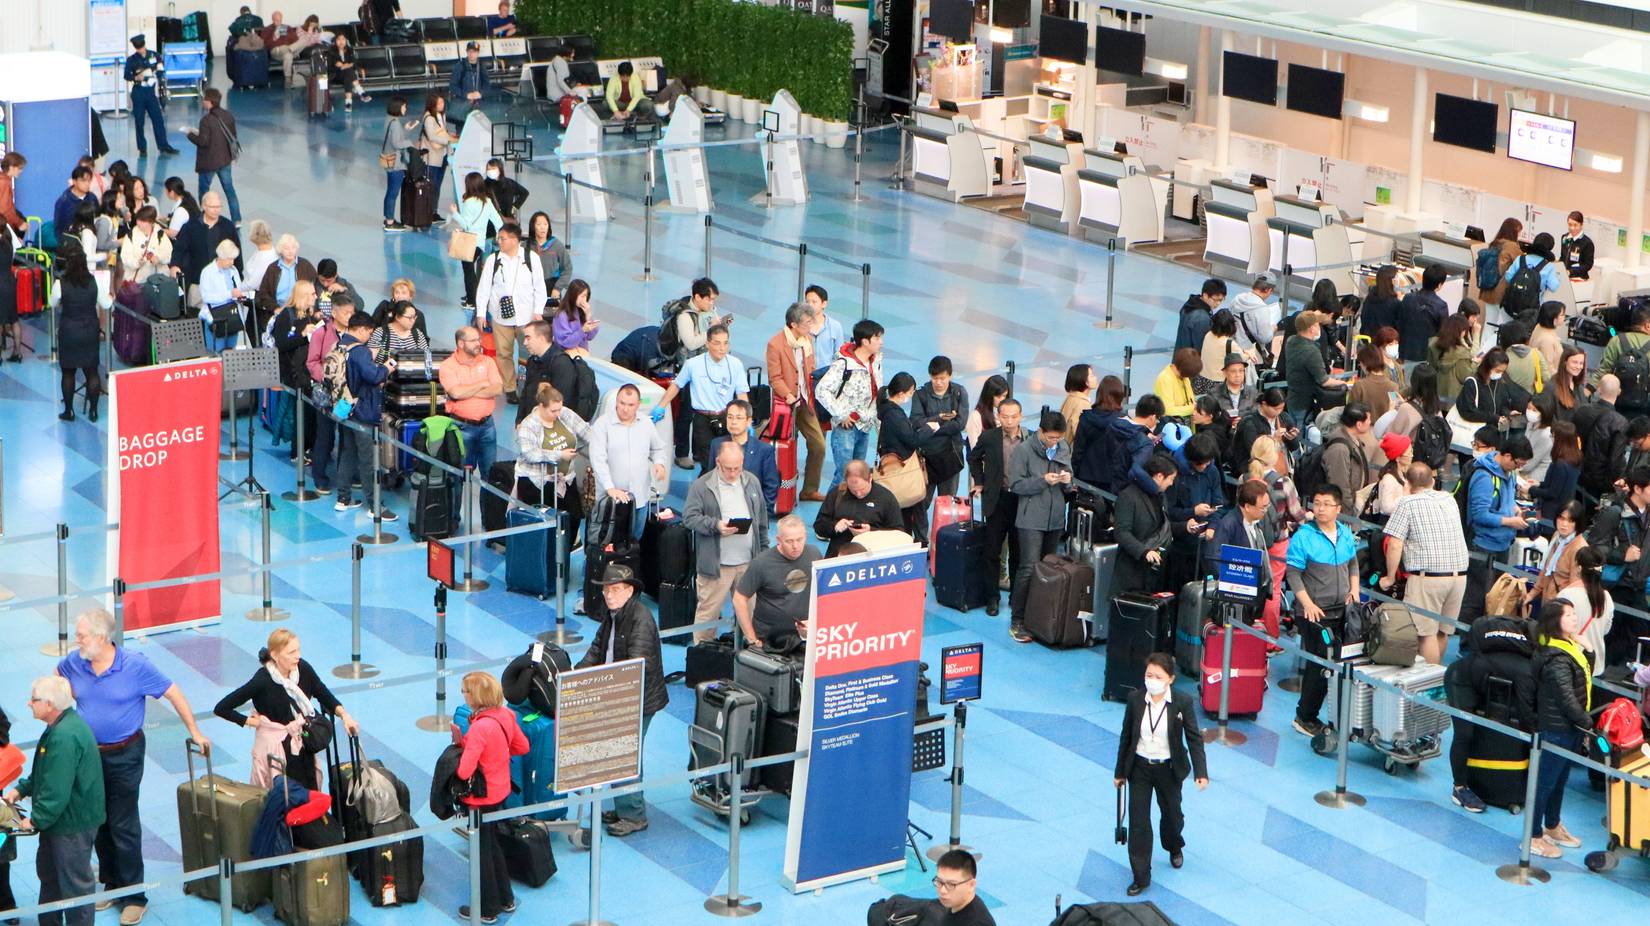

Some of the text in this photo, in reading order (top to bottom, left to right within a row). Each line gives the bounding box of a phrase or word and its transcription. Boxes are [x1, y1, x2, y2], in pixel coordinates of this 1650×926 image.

[174, 368, 208, 380] DELTA
[119, 425, 204, 452] BAGGAGE
[119, 450, 168, 471] DROP
[845, 563, 898, 583] DELTA
[816, 621, 858, 645] SKY
[815, 629, 912, 662] PRIORITY
[954, 647, 972, 655] DELTA
[862, 676, 881, 684] Business
